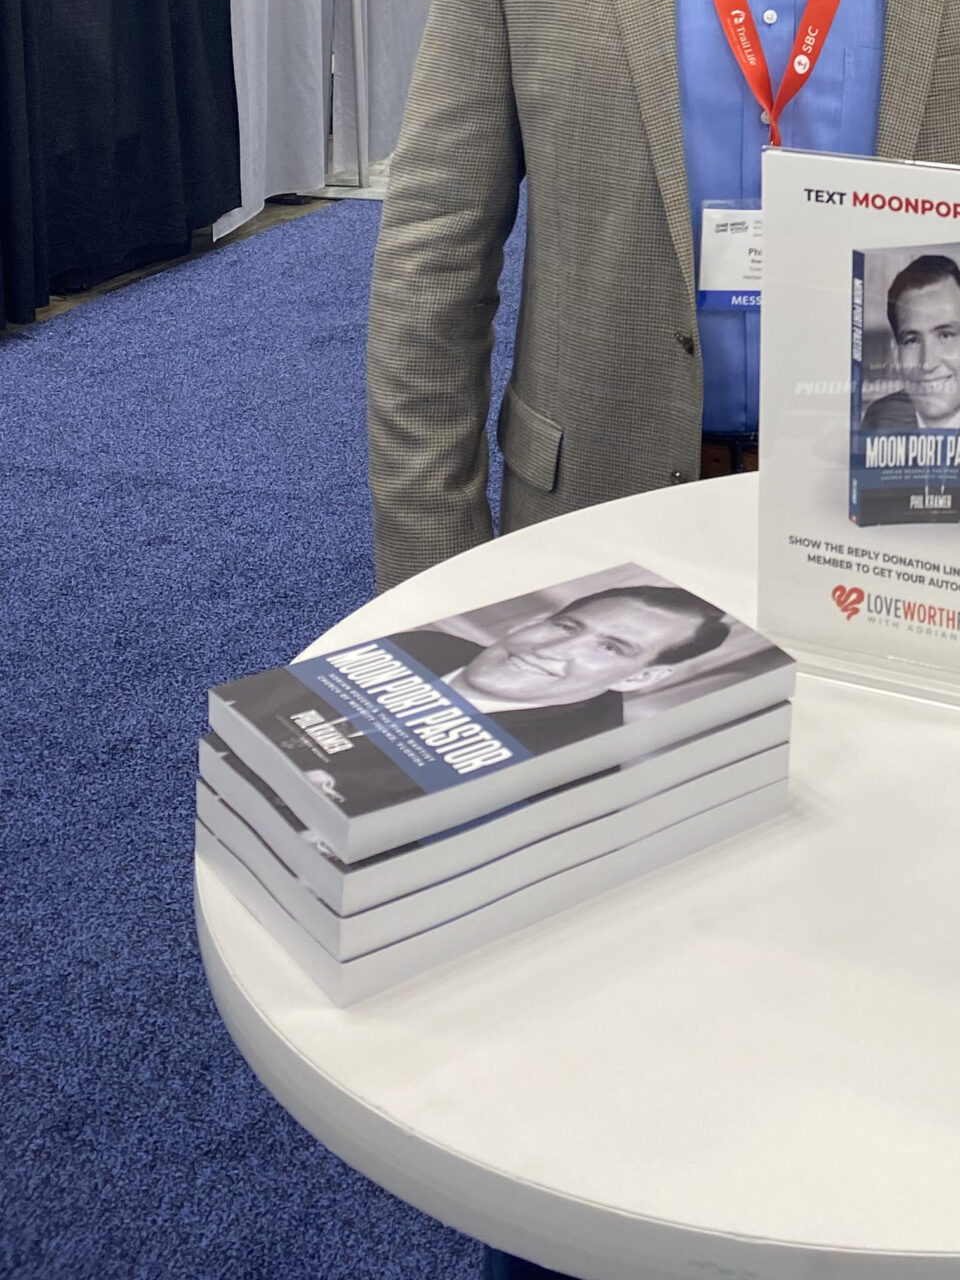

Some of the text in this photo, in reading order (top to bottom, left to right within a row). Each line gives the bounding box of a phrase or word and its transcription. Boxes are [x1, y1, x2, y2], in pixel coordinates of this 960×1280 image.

[737, 27, 750, 48] Trail
[802, 26, 818, 53] SBC
[804, 189, 846, 205] TEXT
[865, 436, 905, 468] MOON
[908, 435, 944, 466] PORT
[788, 535, 821, 550] SHOW
[825, 542, 844, 554] THE
[847, 546, 880, 561] REPLY
[883, 554, 940, 573] DONATION
[807, 554, 852, 570] MEMBER
[856, 563, 870, 573] TO
[873, 566, 892, 579] GET
[896, 571, 925, 585] YOUR
[867, 616, 899, 629] WITH
[907, 624, 957, 641] ADRIAN
[326, 644, 513, 774] MOON PORT PASTOR
